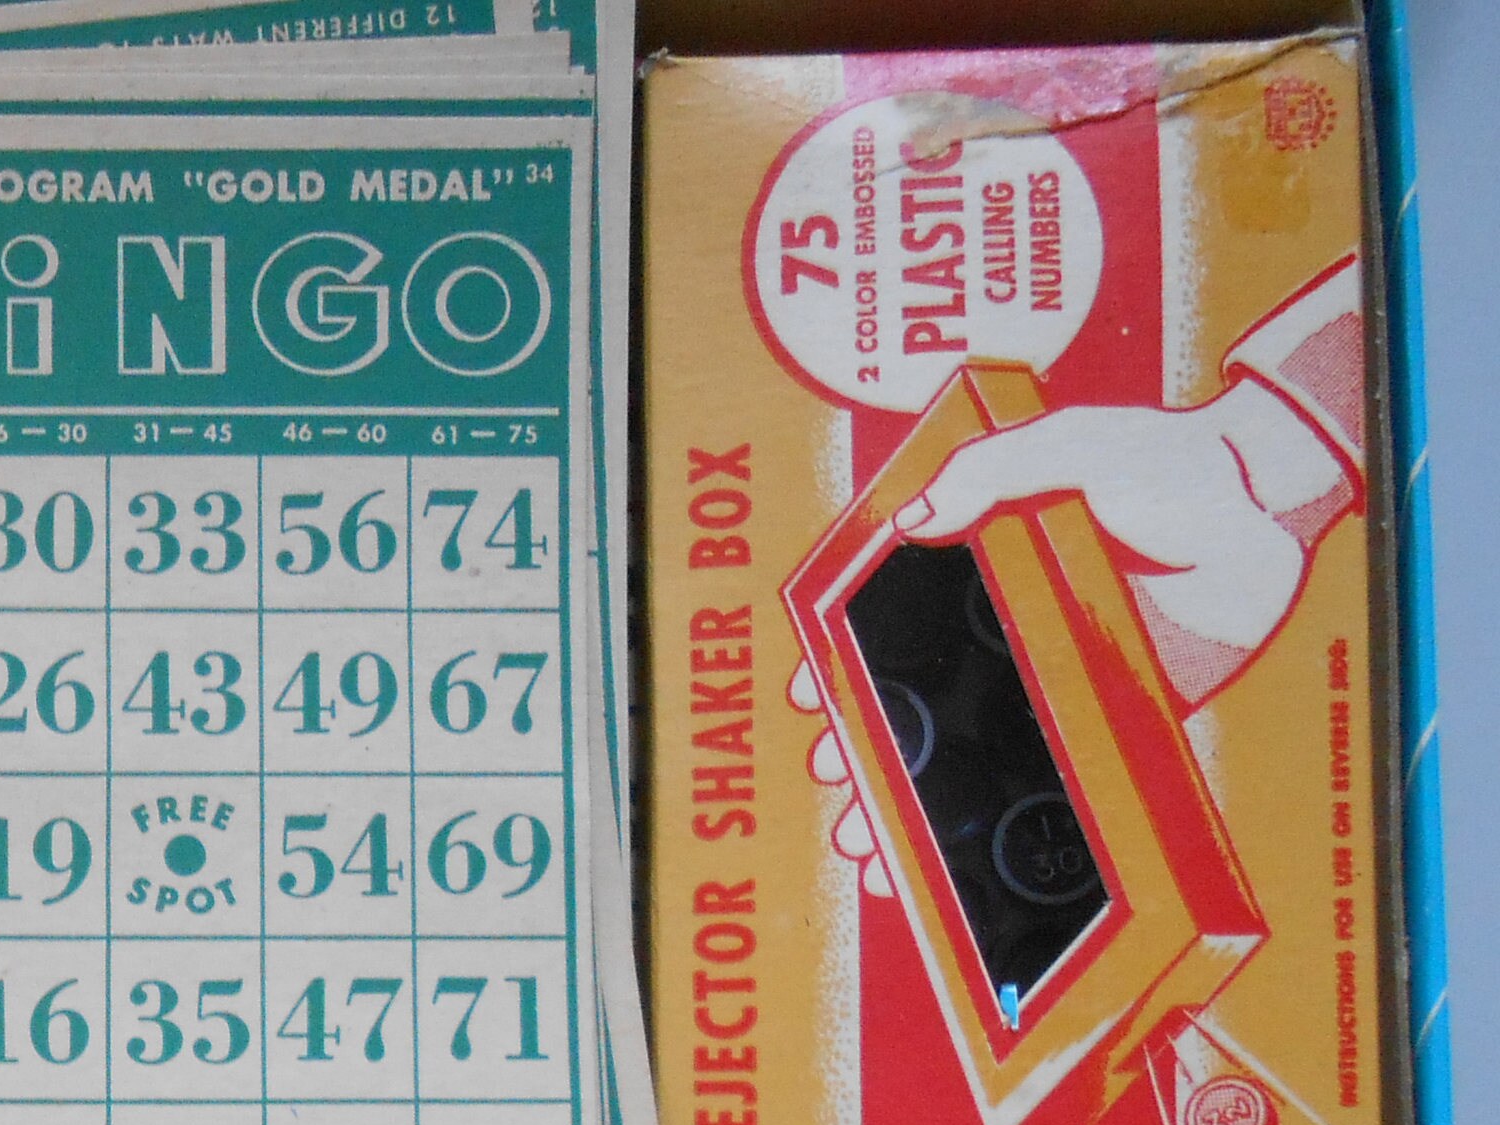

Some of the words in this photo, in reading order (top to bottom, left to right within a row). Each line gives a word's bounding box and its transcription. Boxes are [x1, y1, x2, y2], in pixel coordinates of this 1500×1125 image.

[526, 163, 554, 183] 34
[853, 129, 876, 255] EMBOSSED
[781, 215, 839, 294] 75
[982, 182, 1017, 303] CALLING
[1028, 172, 1062, 310] NUMBERS
[855, 271, 878, 353] COLOR
[857, 365, 880, 383] 2
[125, 491, 245, 574] 33
[276, 490, 397, 574] 56
[424, 489, 547, 571] 74
[688, 443, 751, 569] BOX
[123, 651, 246, 735] 43
[274, 652, 398, 737] 49
[430, 651, 548, 734] 67
[689, 604, 757, 842] SHAKER
[132, 795, 234, 833] FREE
[279, 813, 403, 897] 54
[428, 811, 551, 897] 69
[127, 877, 236, 914] SPOT
[127, 979, 250, 1064] 35
[278, 977, 403, 1061] 47
[433, 977, 548, 1060] 71
